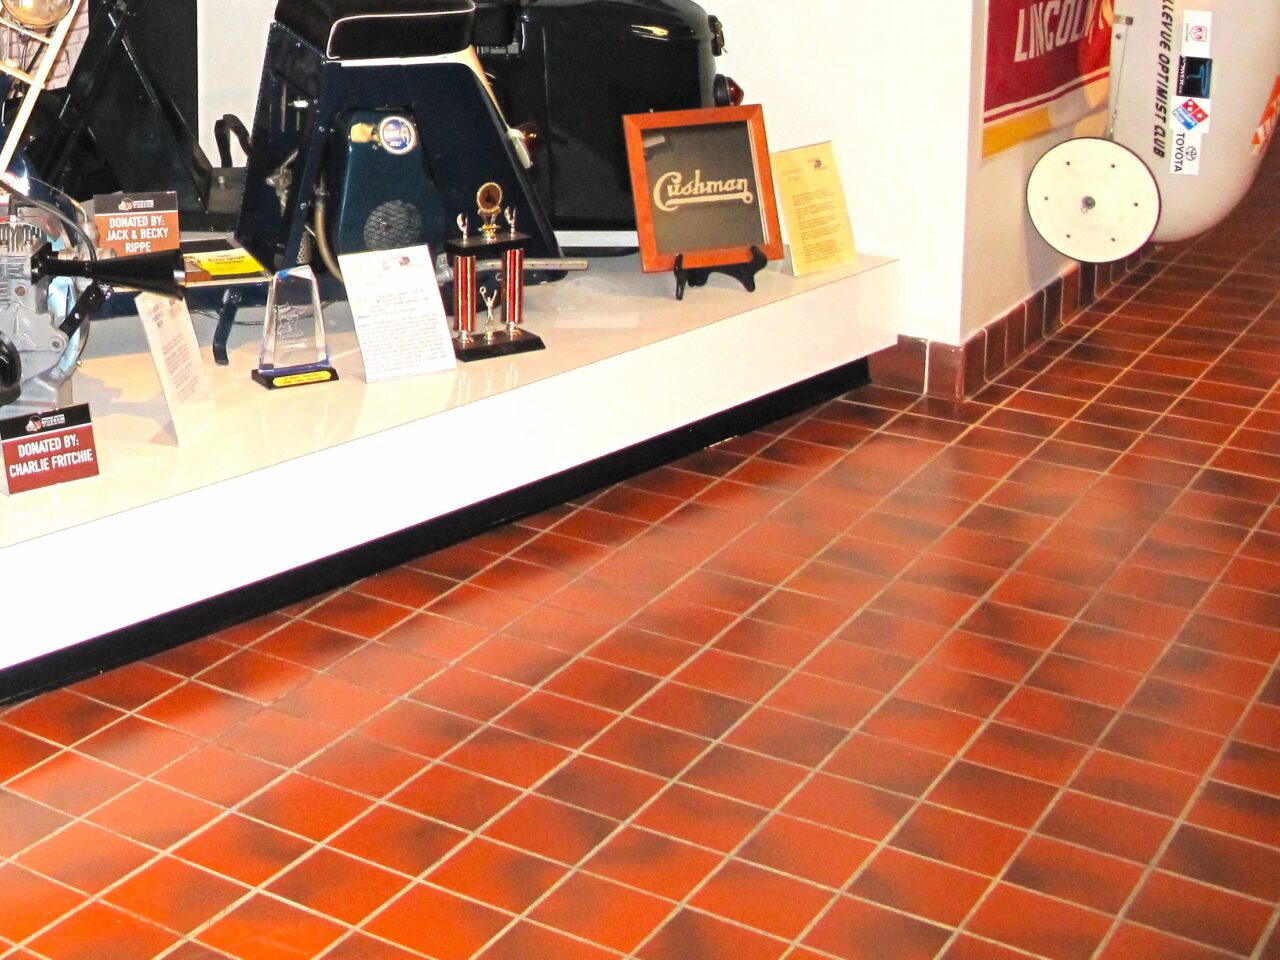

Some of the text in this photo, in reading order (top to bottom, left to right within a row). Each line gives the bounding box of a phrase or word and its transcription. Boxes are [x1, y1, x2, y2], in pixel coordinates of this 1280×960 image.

[1154, 55, 1170, 124] OPTIMIST
[1153, 124, 1167, 159] CLUB
[1174, 132, 1186, 172] TOYOTA
[653, 169, 754, 212] Cushman
[106, 227, 169, 241] JACK & BECKY
[109, 214, 165, 229] DONATED BY:
[125, 241, 152, 253] RIPPE
[17, 433, 80, 458] DONATED BY:
[9, 448, 94, 478] CHARLIE FRITCHIE
